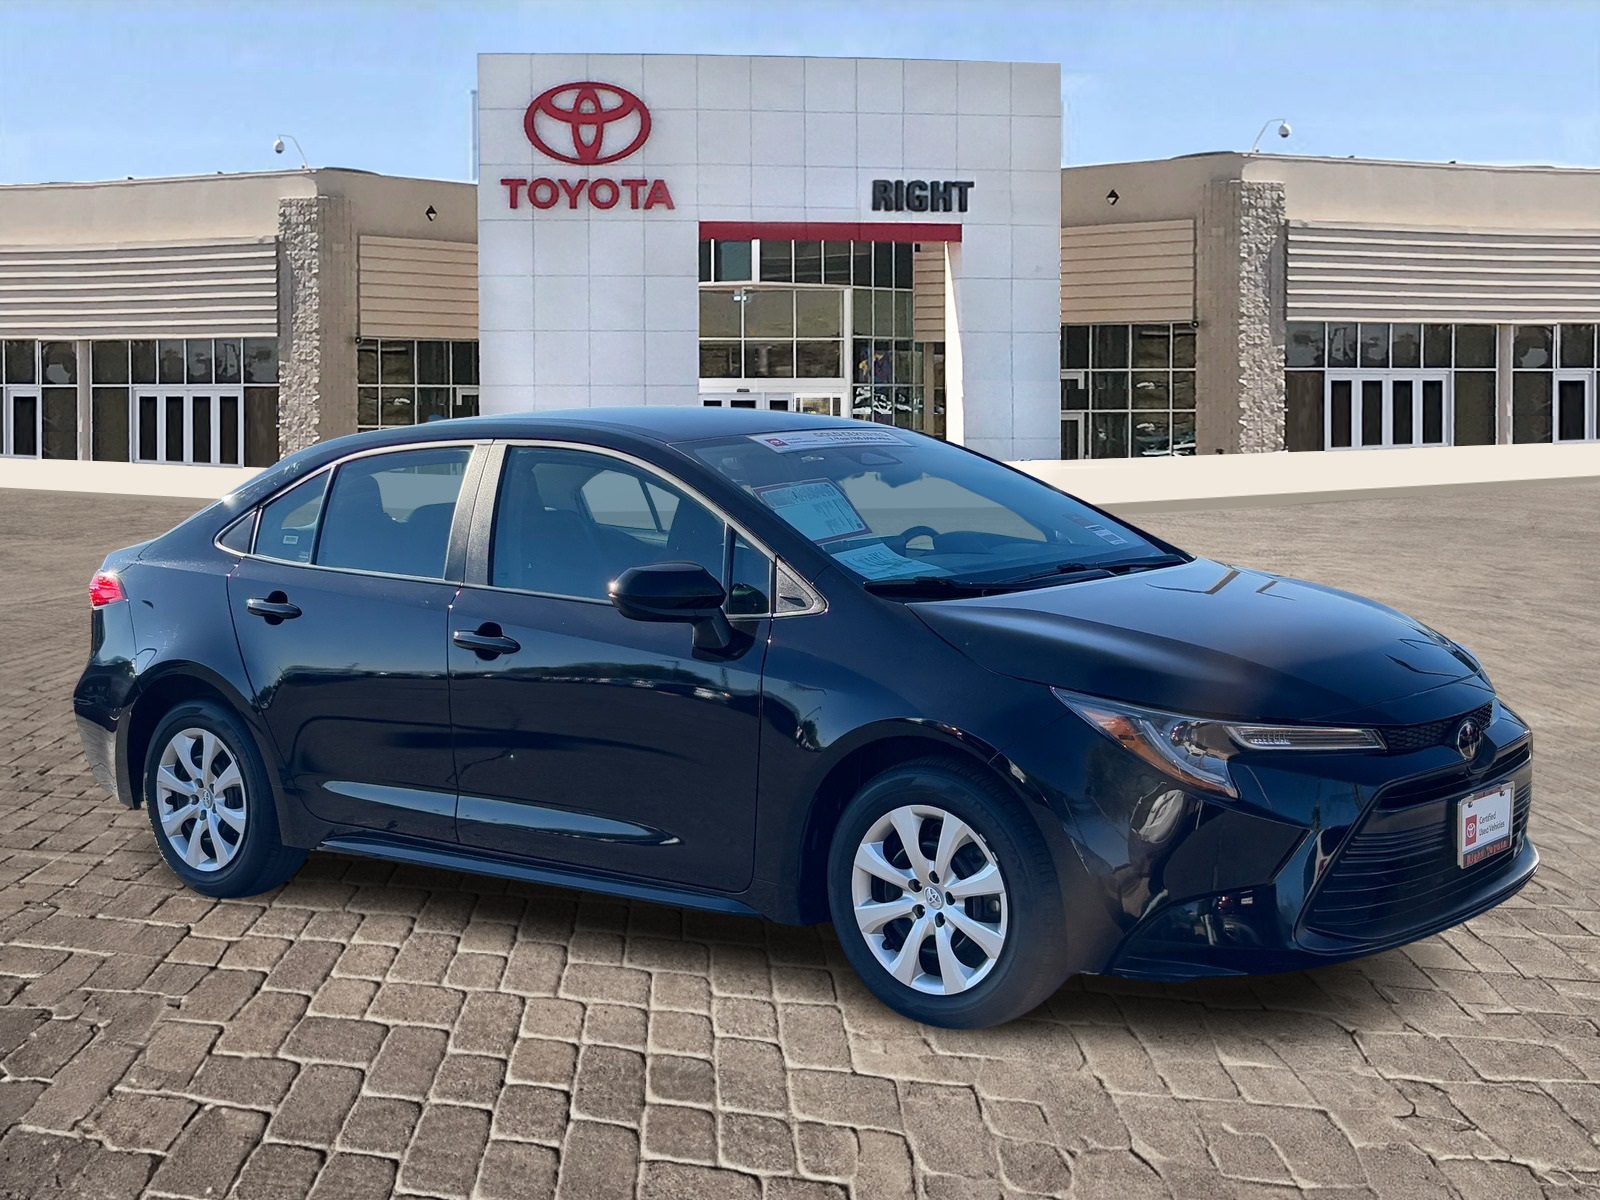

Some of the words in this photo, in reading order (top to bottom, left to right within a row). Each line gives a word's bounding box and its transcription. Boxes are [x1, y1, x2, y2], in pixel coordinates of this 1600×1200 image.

[500, 178, 675, 210] TOYOTA
[871, 179, 975, 212] RIGHT
[1479, 811, 1497, 825] Certified
[1489, 820, 1505, 833] Vehicles
